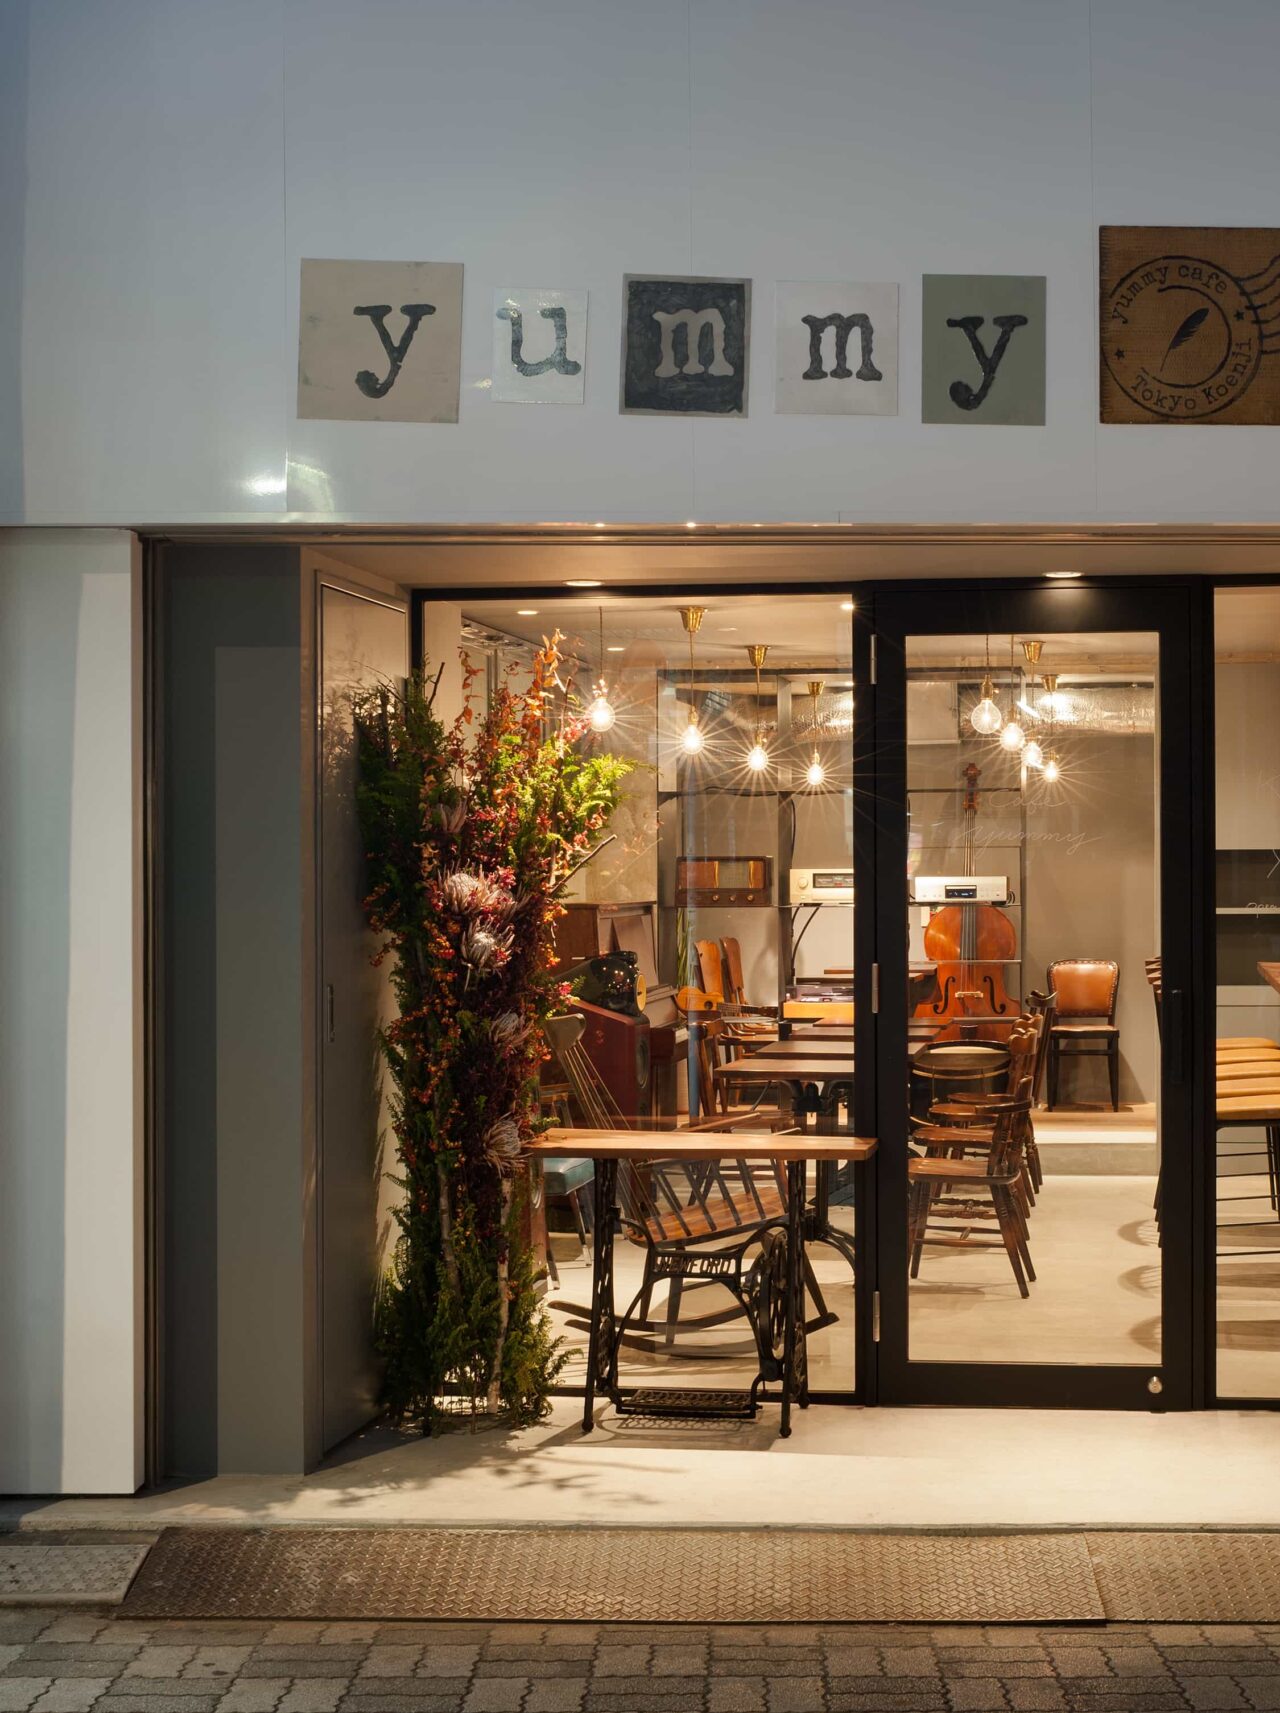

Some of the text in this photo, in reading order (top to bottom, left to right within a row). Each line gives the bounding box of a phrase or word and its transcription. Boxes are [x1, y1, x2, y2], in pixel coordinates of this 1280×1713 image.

[1111, 264, 1228, 325] yummy cafe
[353, 303, 1028, 411] yummy
[1130, 337, 1253, 412] Tokyo Koenji
